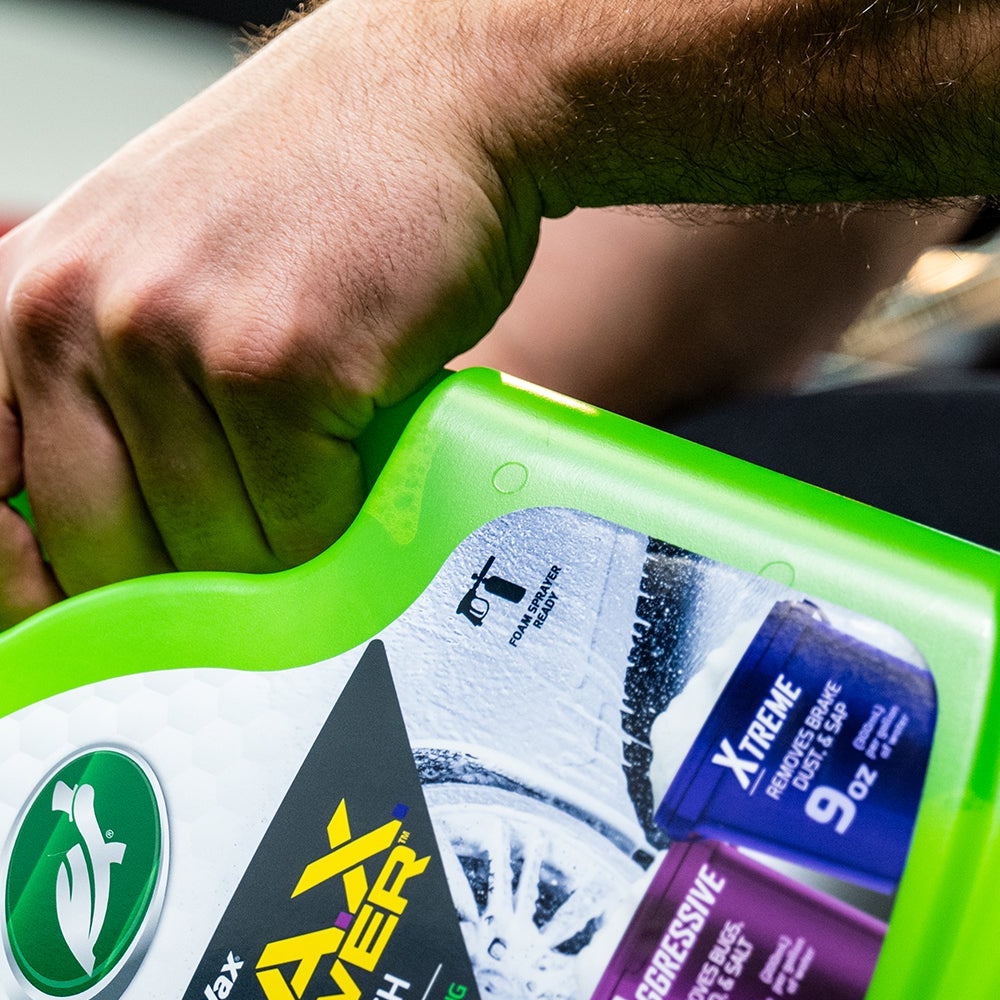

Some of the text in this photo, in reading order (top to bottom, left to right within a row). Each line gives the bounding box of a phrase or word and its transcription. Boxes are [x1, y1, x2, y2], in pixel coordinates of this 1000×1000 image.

[509, 565, 562, 647] FOAM SPRAYER
[532, 591, 558, 629] READY
[711, 673, 802, 790] XTREME
[824, 702, 848, 734] SAP
[765, 679, 842, 800] REMOVES BRAKE
[816, 733, 834, 748] &
[804, 786, 858, 834] 9
[724, 935, 753, 977] SALT
[717, 976, 735, 991] &
